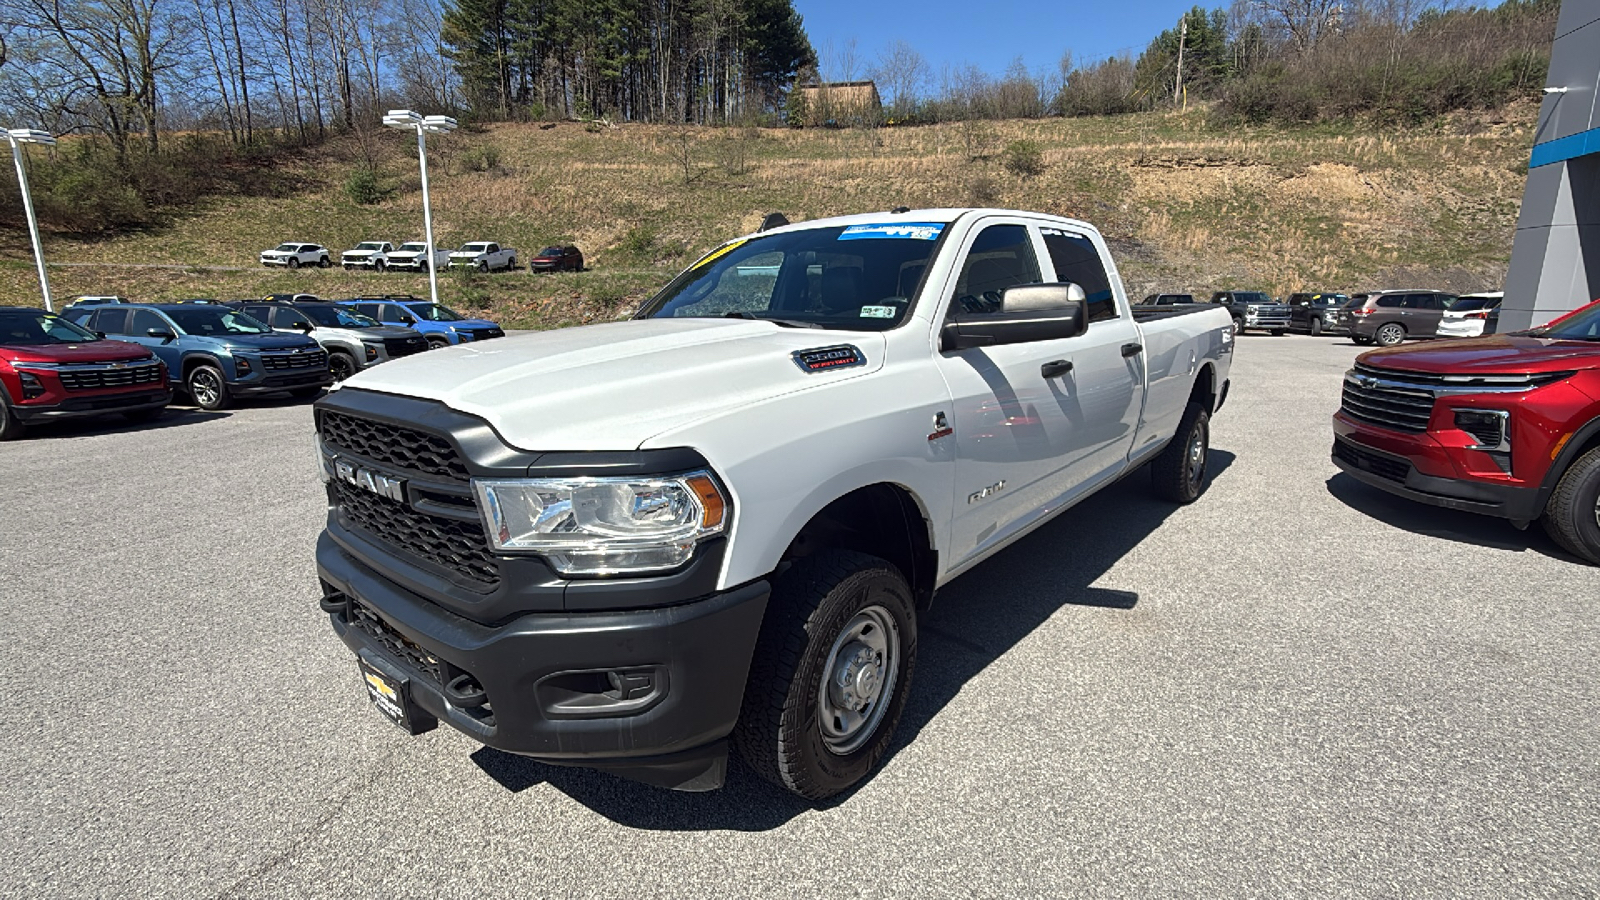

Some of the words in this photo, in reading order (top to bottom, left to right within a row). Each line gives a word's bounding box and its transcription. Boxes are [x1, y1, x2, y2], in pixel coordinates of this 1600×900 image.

[805, 349, 851, 363] 2500
[335, 459, 405, 503] RAM
[968, 479, 1007, 505] RAM
